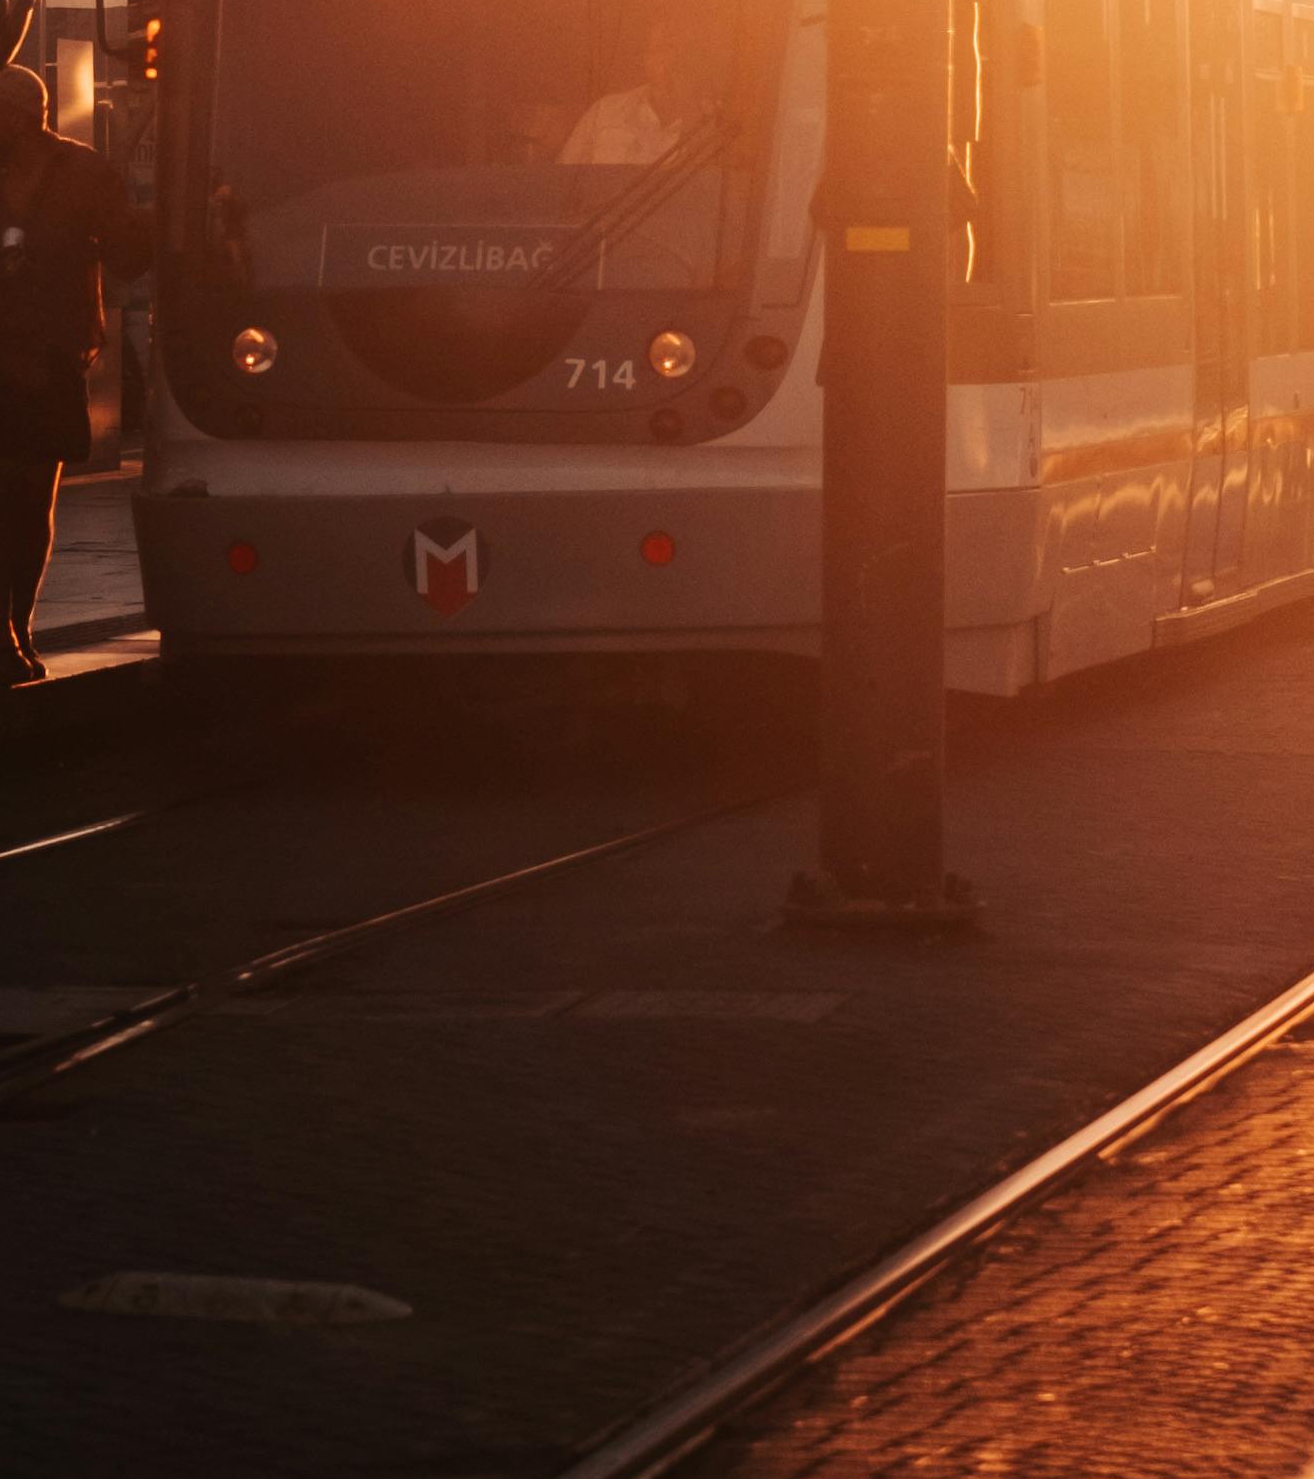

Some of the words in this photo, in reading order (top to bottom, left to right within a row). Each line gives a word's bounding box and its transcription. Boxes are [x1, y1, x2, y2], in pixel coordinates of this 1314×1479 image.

[367, 239, 554, 272] CEVİZLİBAĞ
[564, 357, 637, 390] 714
[413, 528, 478, 594] M
